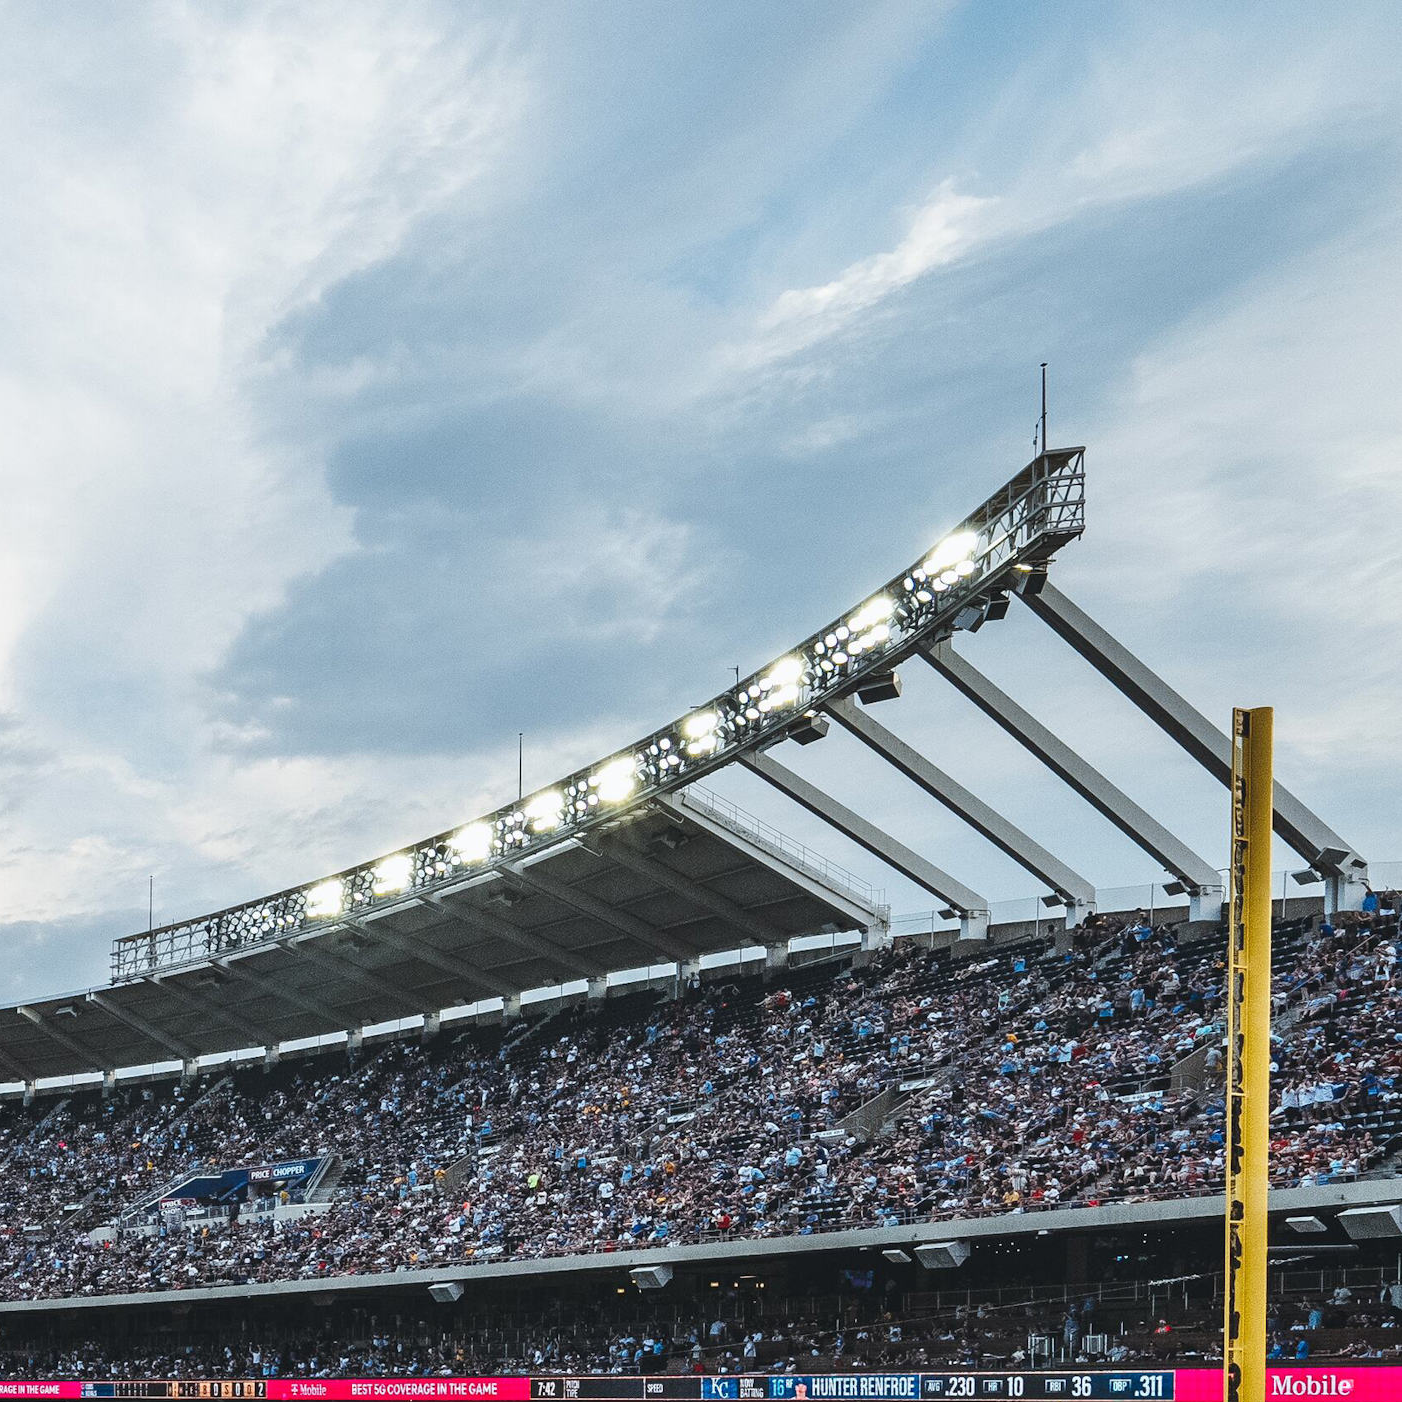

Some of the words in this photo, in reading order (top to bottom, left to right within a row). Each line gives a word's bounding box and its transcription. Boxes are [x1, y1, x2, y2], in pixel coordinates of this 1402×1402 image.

[251, 1169, 270, 1180] PRICE
[272, 1165, 305, 1177] CHOPPER
[18, 1385, 26, 1394] IN
[26, 1385, 38, 1395] THE
[39, 1385, 60, 1395] GAME
[258, 1383, 264, 1396] 2
[300, 1384, 327, 1396] Mobile
[351, 1384, 372, 1396] BEST
[374, 1384, 386, 1396] 5G
[387, 1383, 436, 1395] COVERAGE
[437, 1383, 447, 1395] IN
[448, 1383, 466, 1395] THE
[468, 1383, 498, 1395] GAME
[537, 1382, 556, 1396] 7:42
[647, 1383, 664, 1394] SPEED
[710, 1377, 729, 1399] KC
[740, 1378, 755, 1388] NOW
[772, 1378, 785, 1397] 16
[812, 1377, 858, 1396] HUNTER
[860, 1376, 915, 1396] RENFROE
[927, 1381, 941, 1392] AVG
[945, 1376, 976, 1397] .230
[988, 1381, 998, 1392] HR
[1006, 1376, 1024, 1397] 10
[1049, 1381, 1062, 1392] RBI
[1071, 1376, 1092, 1397] 36
[1112, 1381, 1127, 1392] OBP
[1134, 1375, 1163, 1397] .311
[1271, 1373, 1351, 1395] Mobile
[740, 1387, 764, 1398] BATTING
